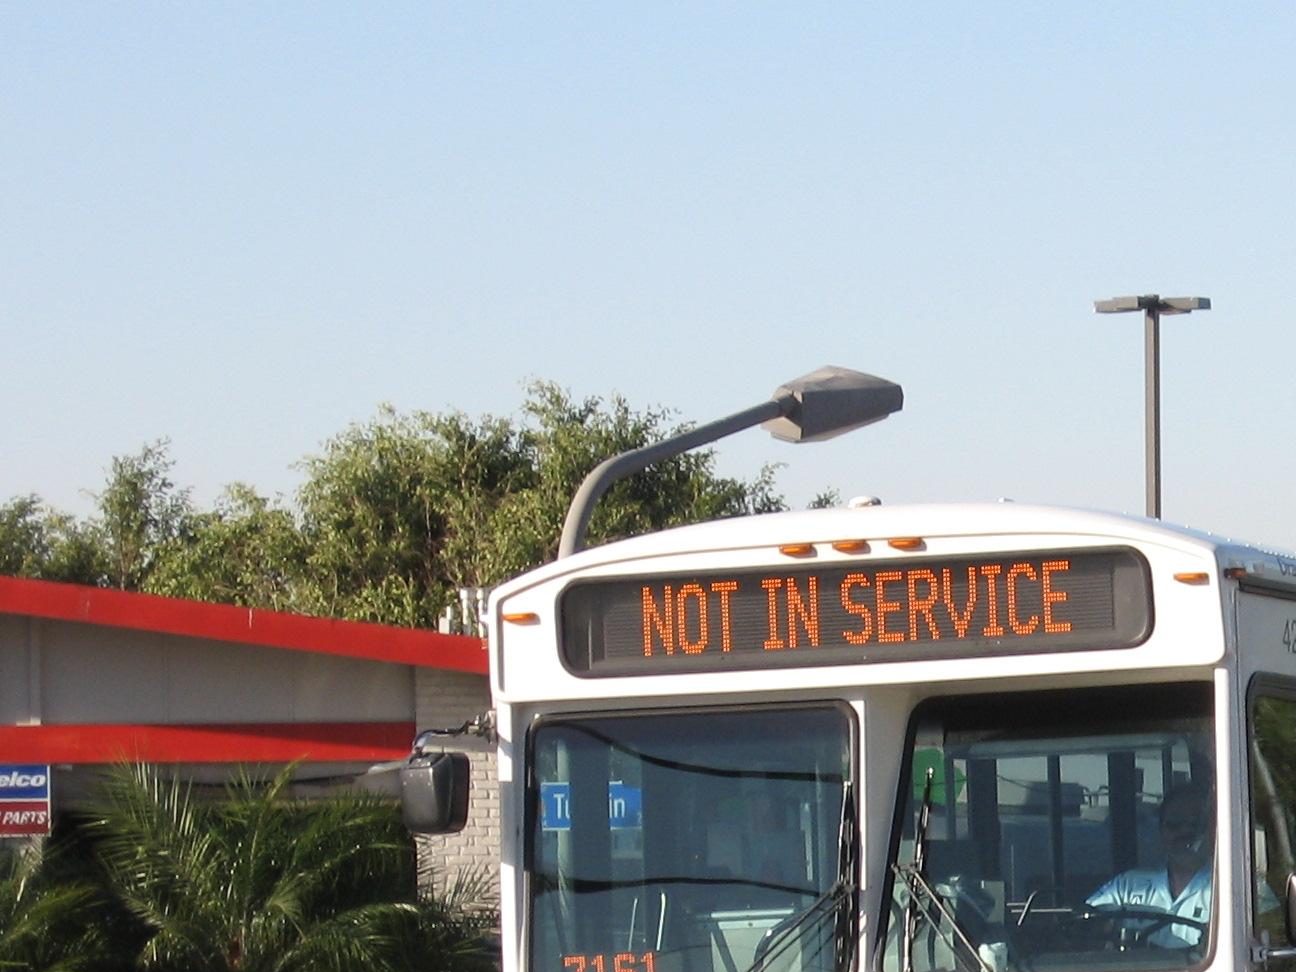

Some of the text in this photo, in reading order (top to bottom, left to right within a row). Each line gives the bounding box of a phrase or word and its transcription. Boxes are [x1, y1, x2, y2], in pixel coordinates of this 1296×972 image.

[642, 560, 1072, 656] NOT IN SERVICE
[2, 811, 47, 825] PARTS
